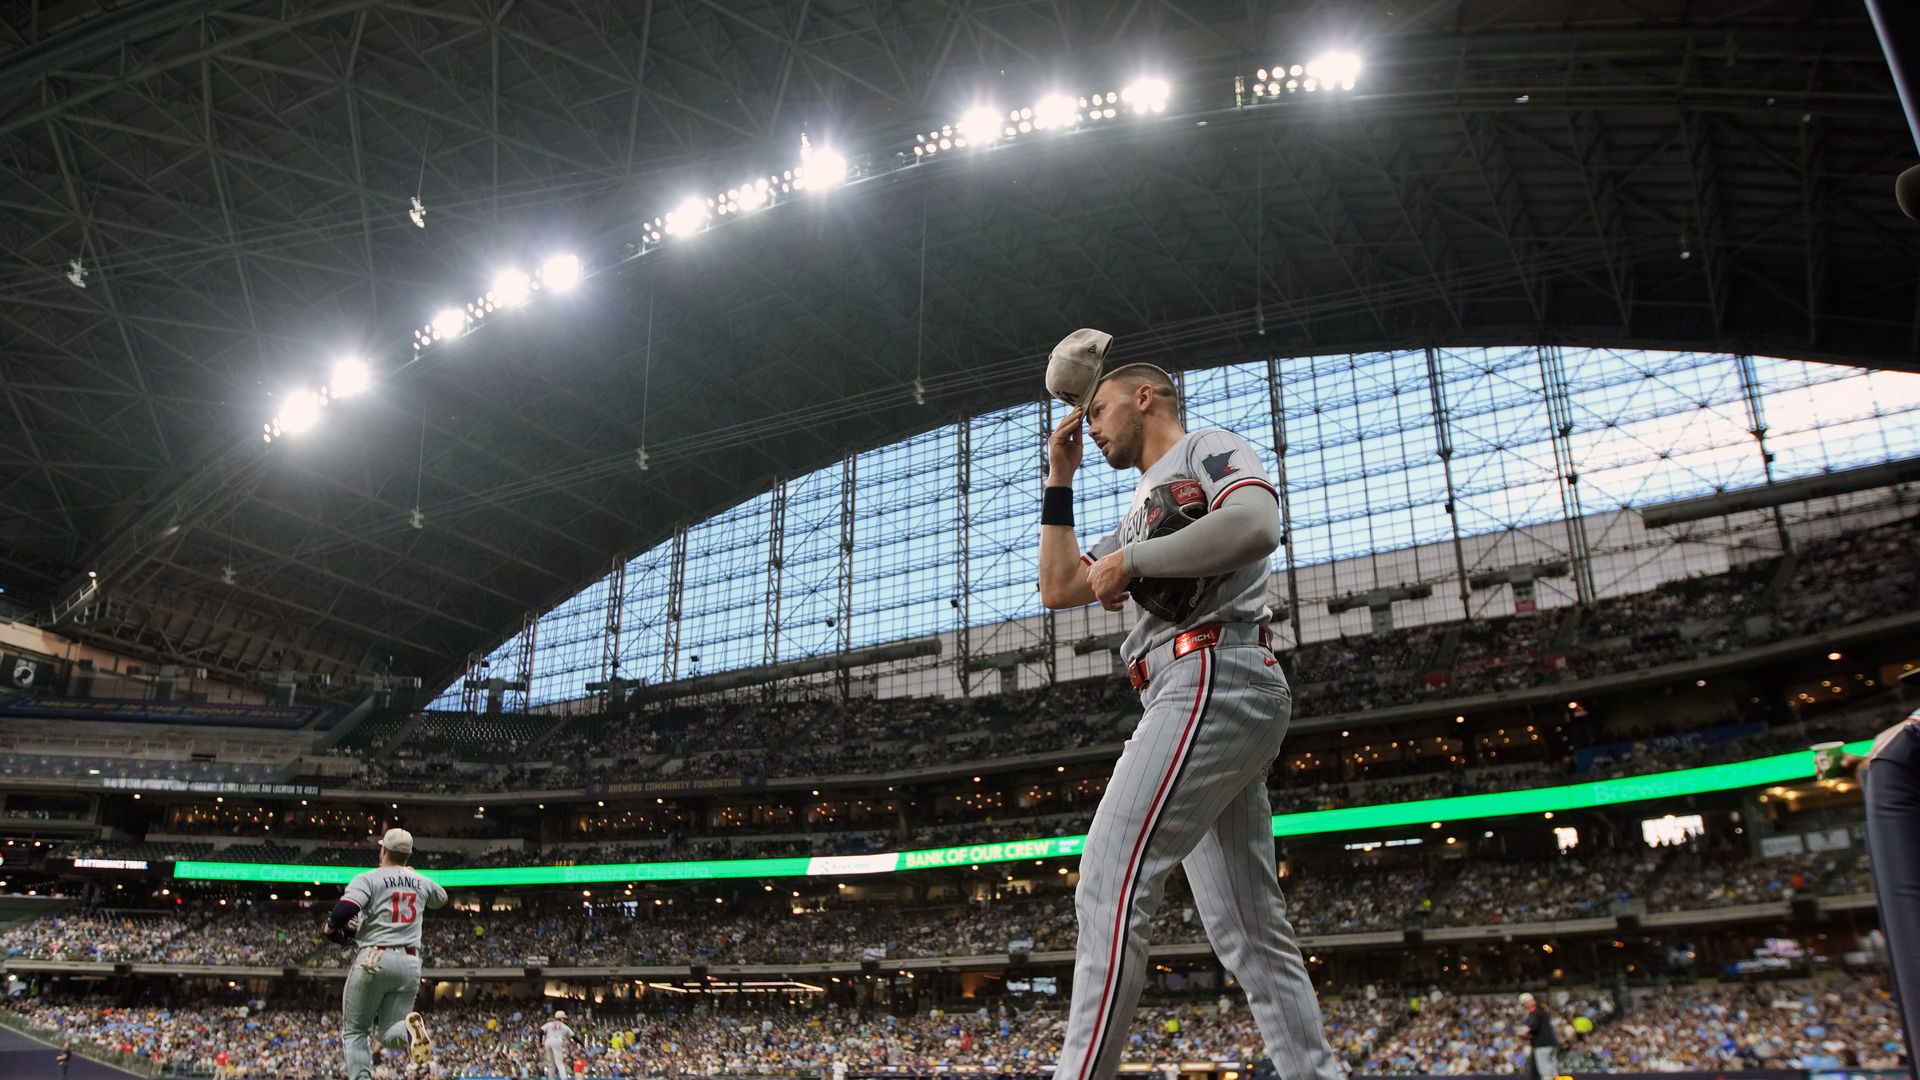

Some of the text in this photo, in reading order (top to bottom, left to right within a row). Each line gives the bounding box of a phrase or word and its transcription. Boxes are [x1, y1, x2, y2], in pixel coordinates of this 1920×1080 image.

[608, 778, 742, 793] BREWERS COMMUNITY FOUNDATION
[906, 853, 945, 868] BANK
[945, 849, 967, 864] OF
[970, 845, 1002, 862] OUR
[1005, 841, 1050, 859] CREW
[179, 863, 249, 879] Brewers
[383, 876, 422, 889] FRANCE
[392, 892, 417, 924] 13
